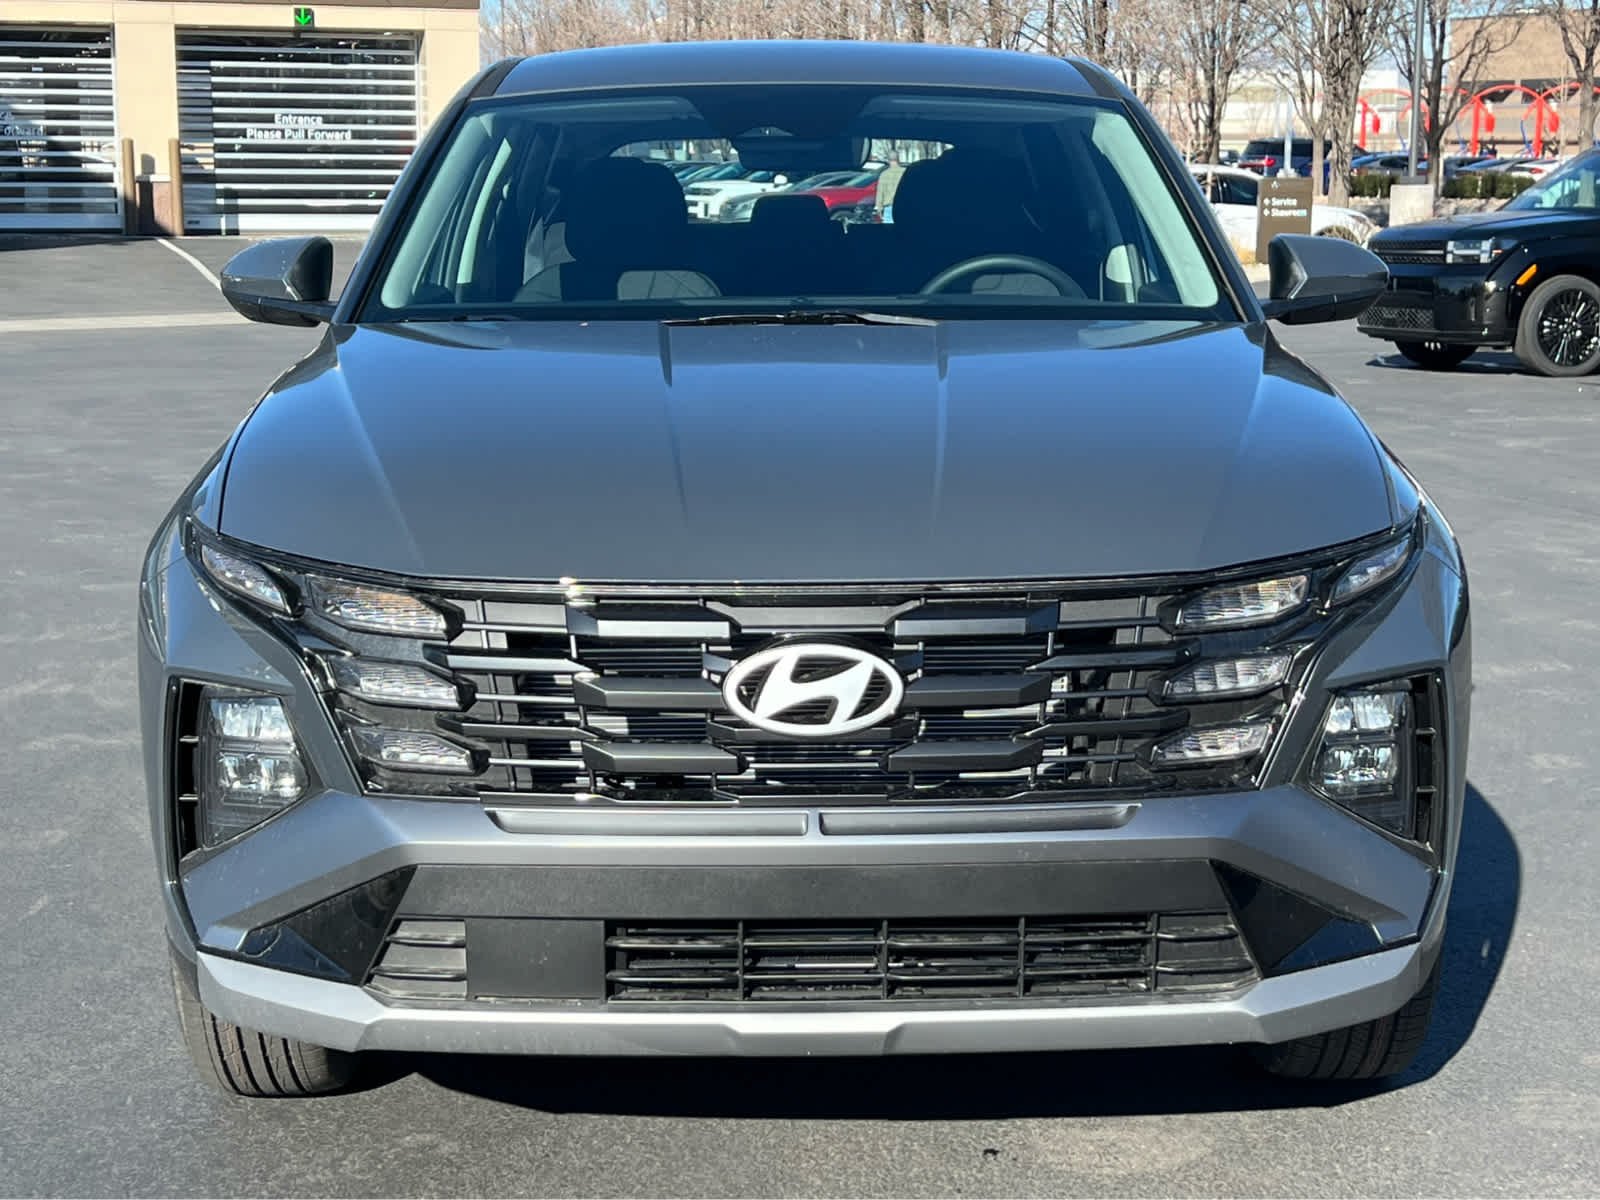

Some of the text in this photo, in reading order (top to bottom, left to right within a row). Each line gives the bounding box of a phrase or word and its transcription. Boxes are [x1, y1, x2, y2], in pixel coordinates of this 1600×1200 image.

[274, 113, 323, 126] Entrance
[246, 128, 352, 140] Please Pull Forward
[1271, 197, 1297, 206] Service
